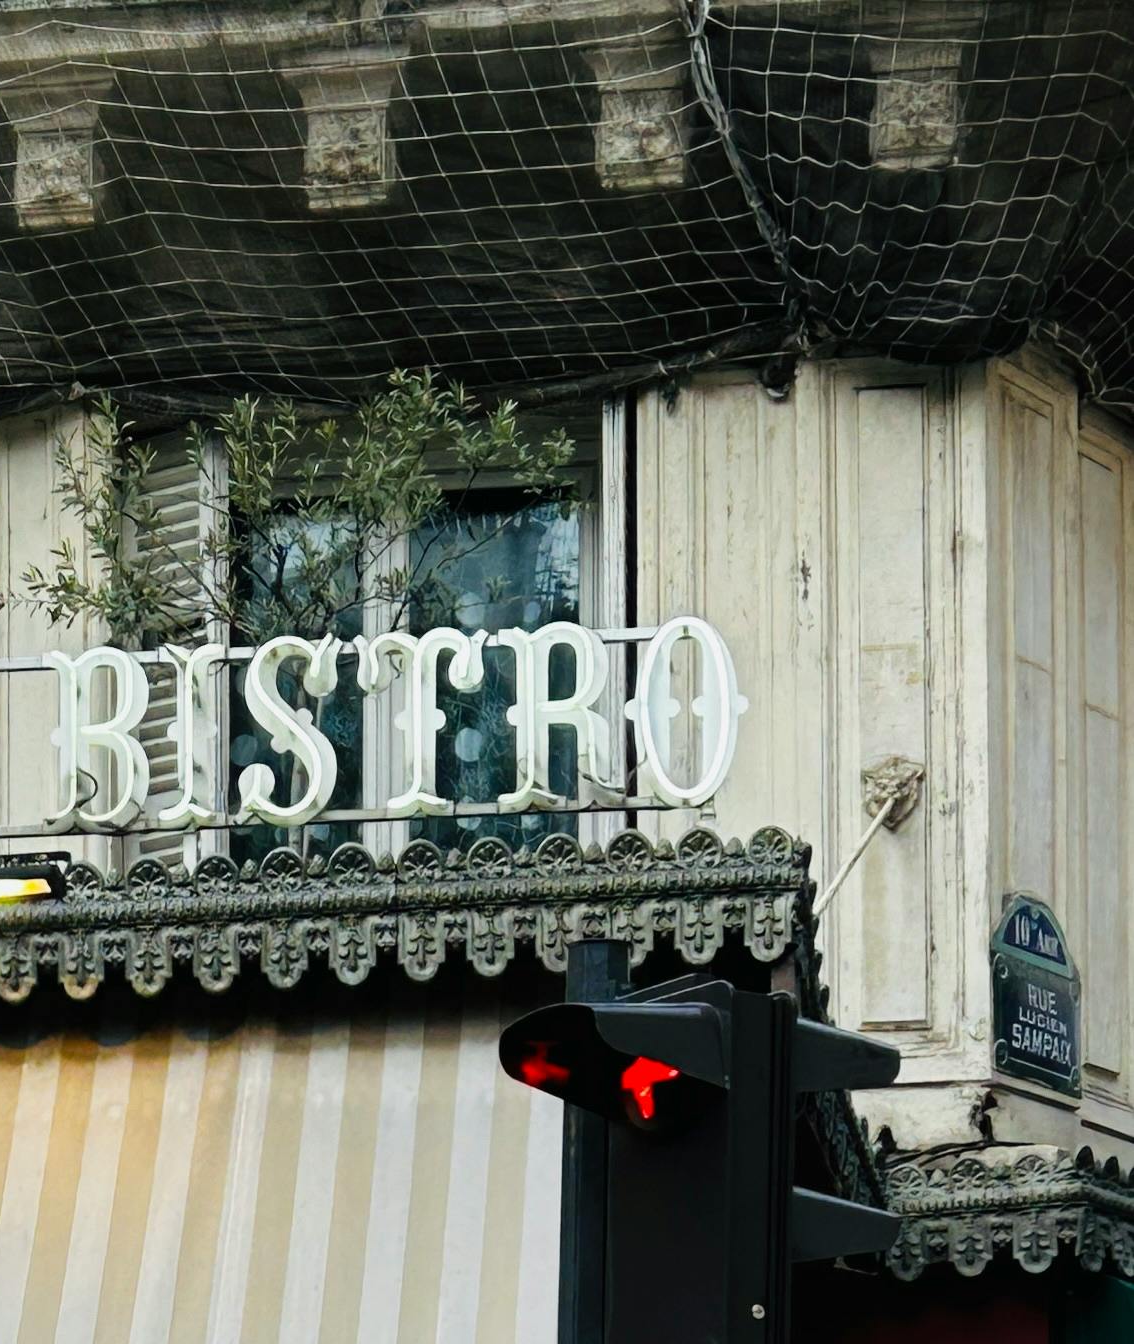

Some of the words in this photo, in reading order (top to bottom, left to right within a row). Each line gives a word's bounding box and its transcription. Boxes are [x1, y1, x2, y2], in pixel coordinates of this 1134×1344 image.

[43, 616, 748, 831] BISTRO
[1027, 983, 1058, 1015] RUE
[1019, 1006, 1067, 1036] LUCIEN
[1011, 1023, 1073, 1067] SAMPAIX
